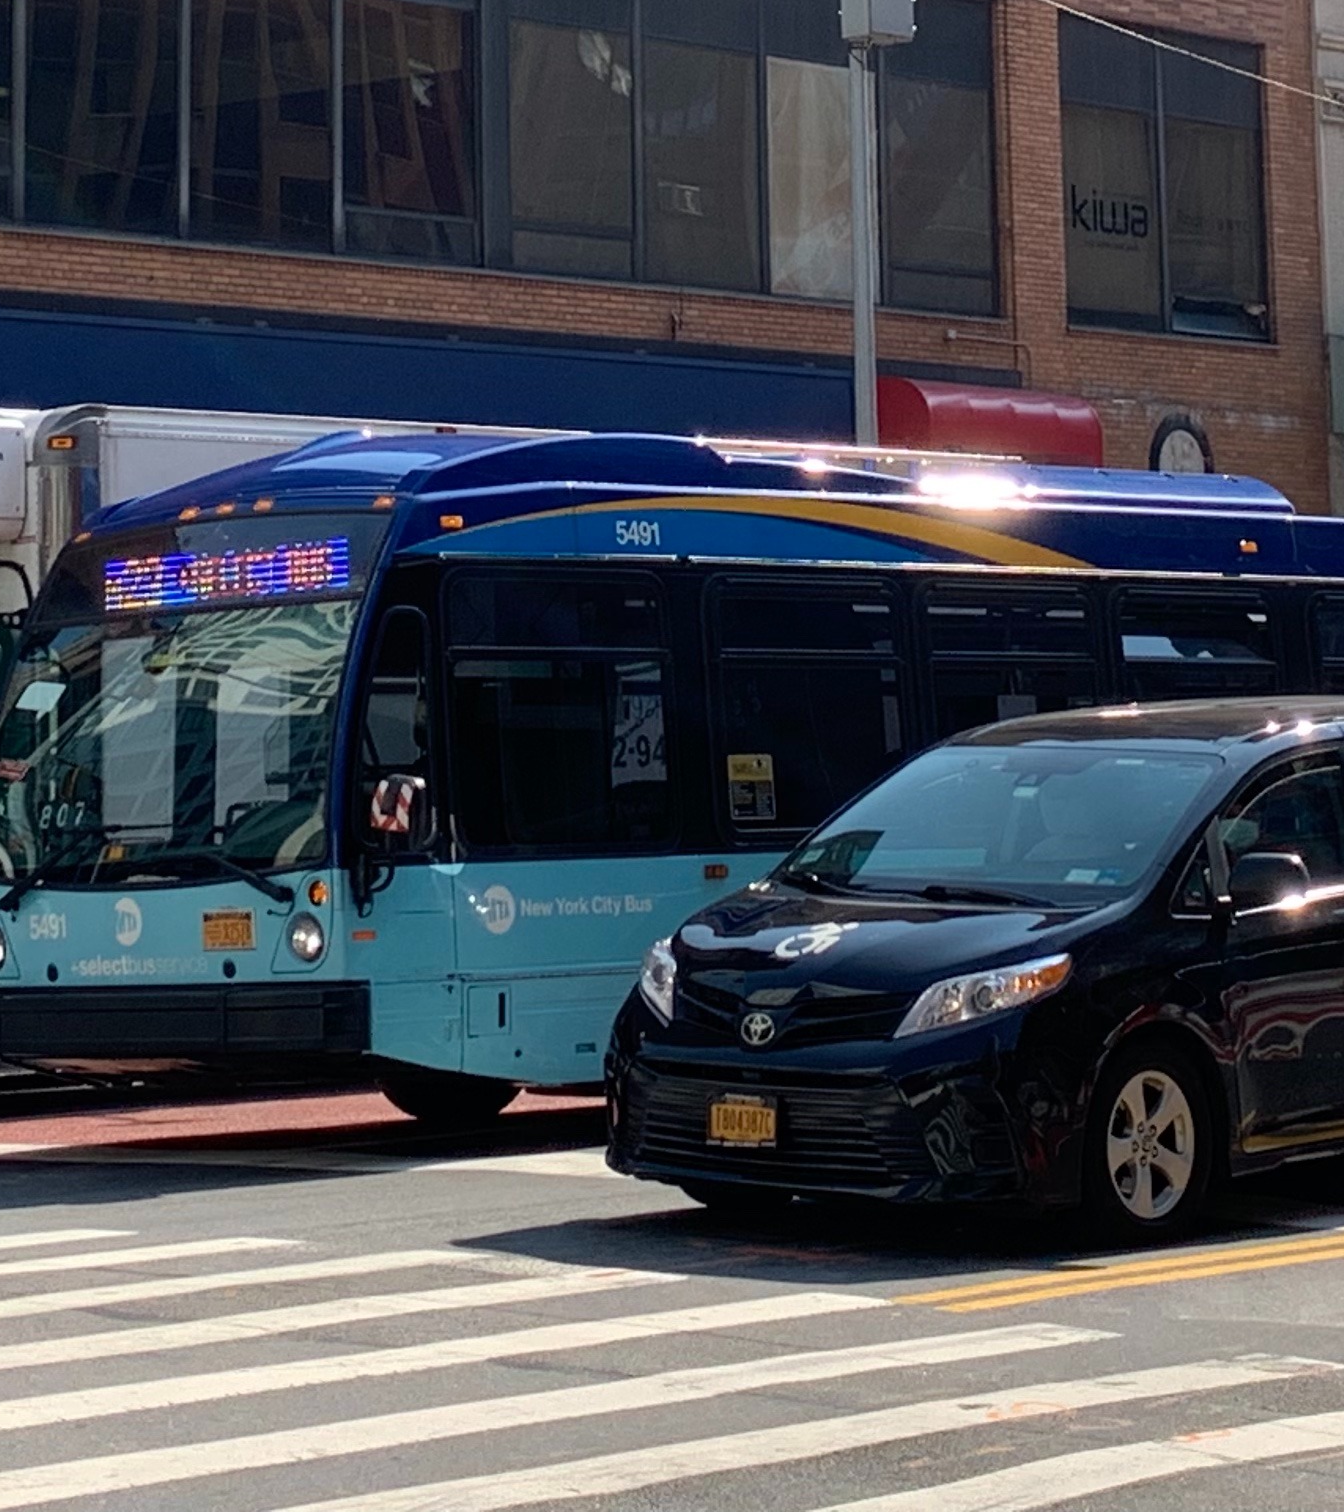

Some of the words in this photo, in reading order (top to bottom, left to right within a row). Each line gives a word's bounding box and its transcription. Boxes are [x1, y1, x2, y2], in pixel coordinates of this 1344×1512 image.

[1070, 183, 1149, 239] kiwa
[615, 521, 662, 547] 5491
[521, 899, 552, 917] New
[555, 896, 590, 916] York
[591, 895, 621, 918] City
[624, 894, 654, 913] Bus
[29, 913, 67, 940] 5491
